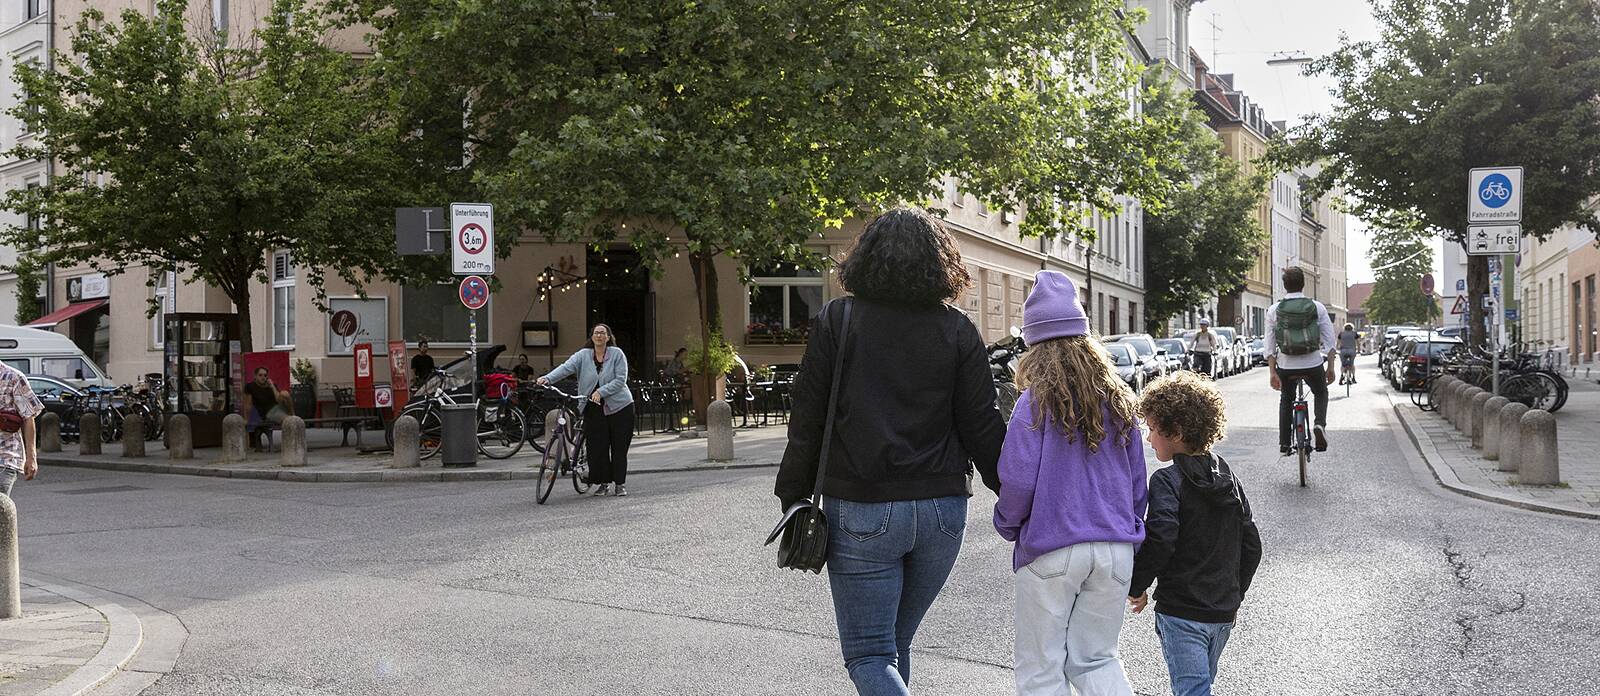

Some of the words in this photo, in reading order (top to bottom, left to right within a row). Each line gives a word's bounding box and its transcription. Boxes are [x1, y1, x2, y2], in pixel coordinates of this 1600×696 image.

[455, 209, 489, 218] Unterführung
[1496, 232, 1518, 244] frei
[463, 261, 476, 269] 200
